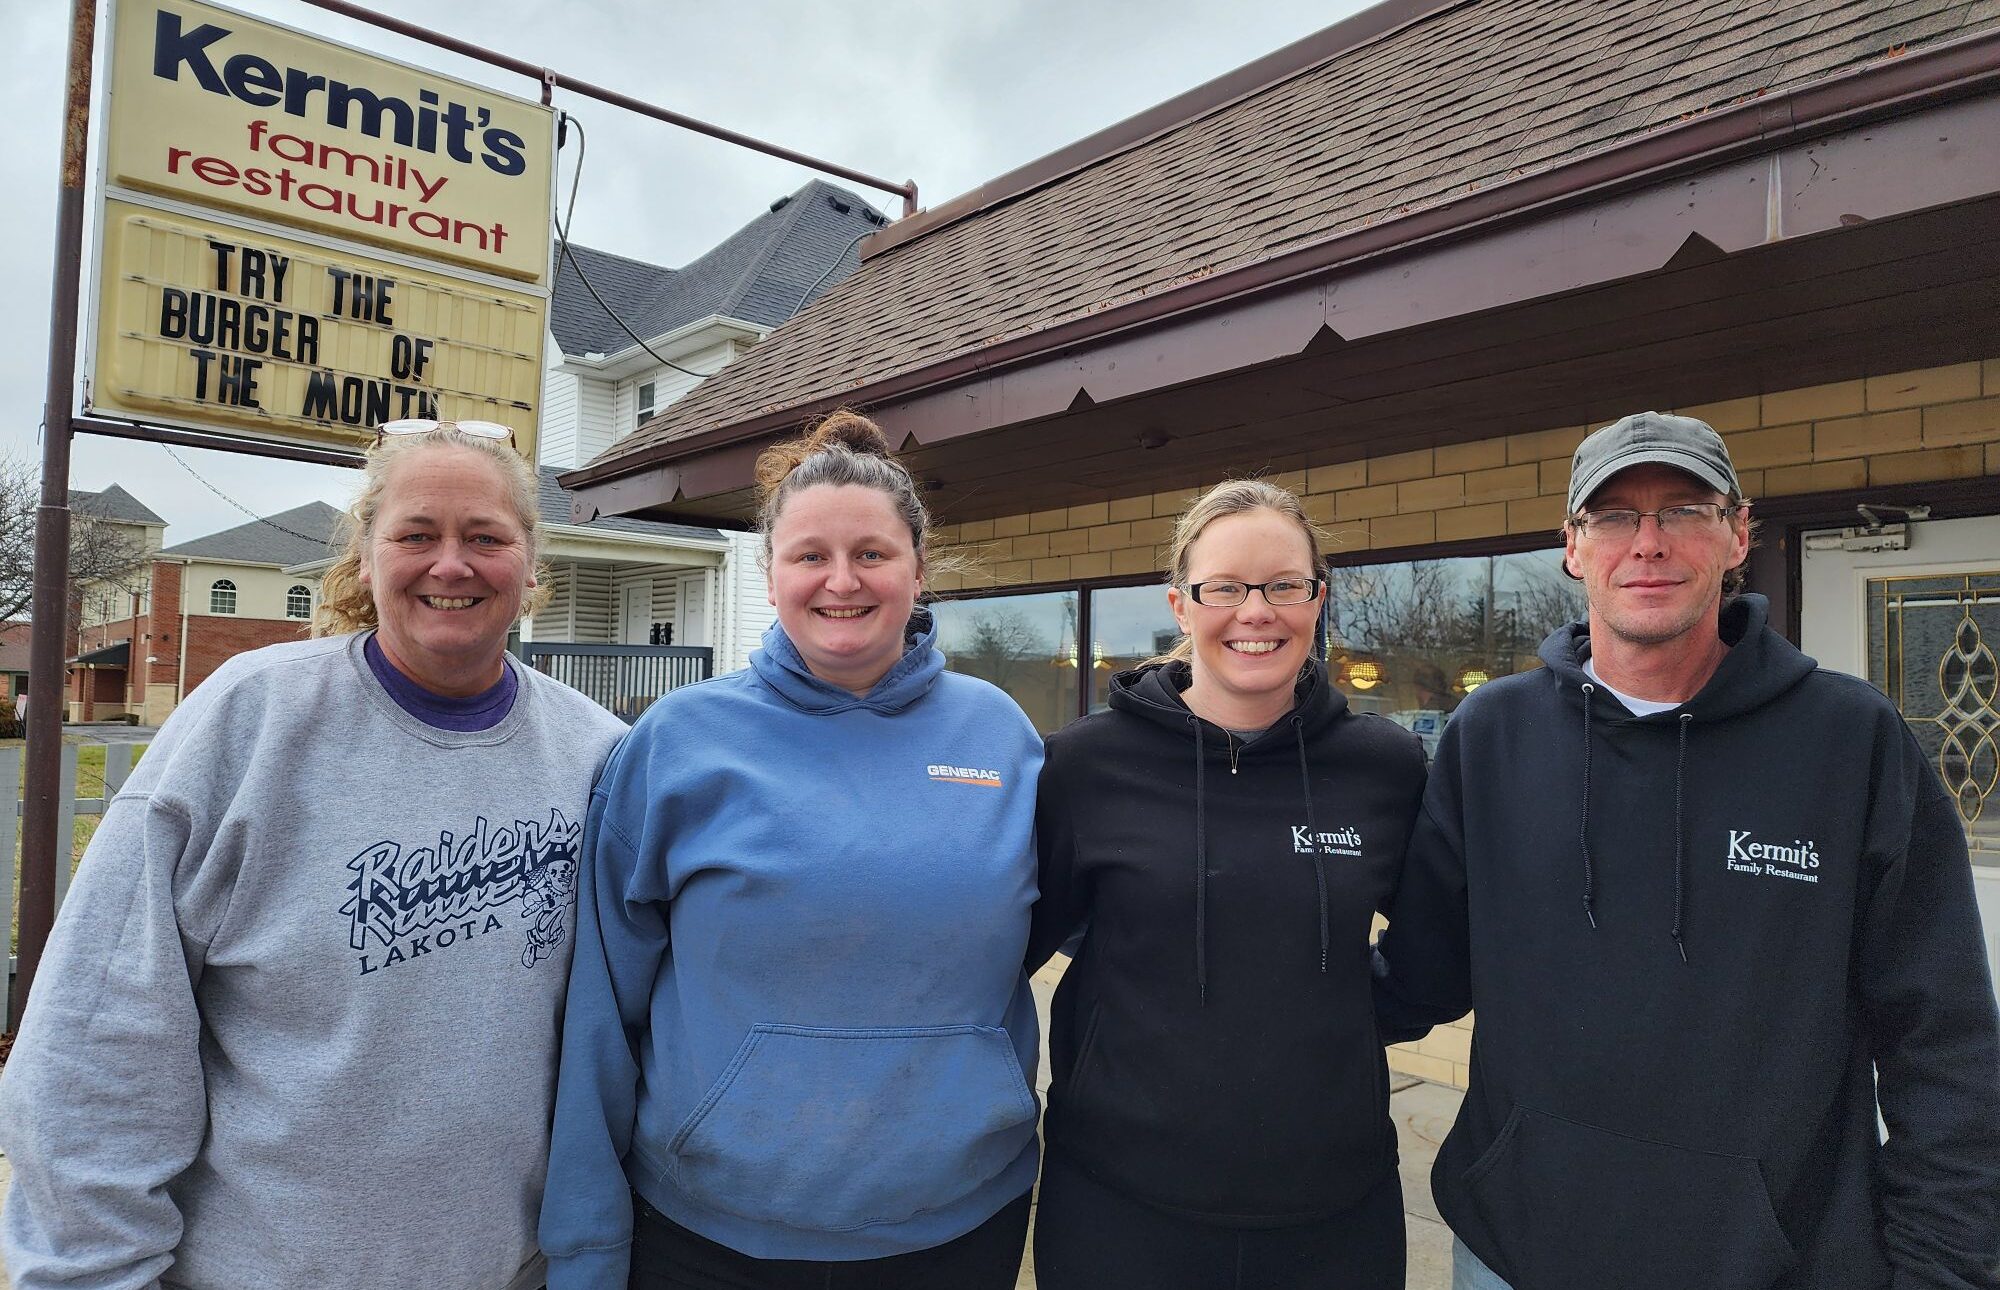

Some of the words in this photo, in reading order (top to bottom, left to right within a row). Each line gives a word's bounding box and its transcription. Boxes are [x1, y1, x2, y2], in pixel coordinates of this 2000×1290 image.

[153, 9, 526, 176] Kermit's
[167, 147, 508, 254] restaurant
[247, 120, 449, 203] family
[209, 241, 289, 303] TRY
[328, 268, 395, 326] THE
[160, 287, 319, 364] BURGER
[390, 334, 434, 382] OF
[190, 349, 263, 408] THE
[302, 370, 439, 427] MONTH
[927, 764, 1000, 780] GENERAC
[343, 808, 581, 912] Raiders
[1727, 829, 1820, 869] Kermit's
[1727, 859, 1762, 876] Family
[1765, 863, 1819, 883] Restaurant
[359, 913, 503, 976] LAKOTA
